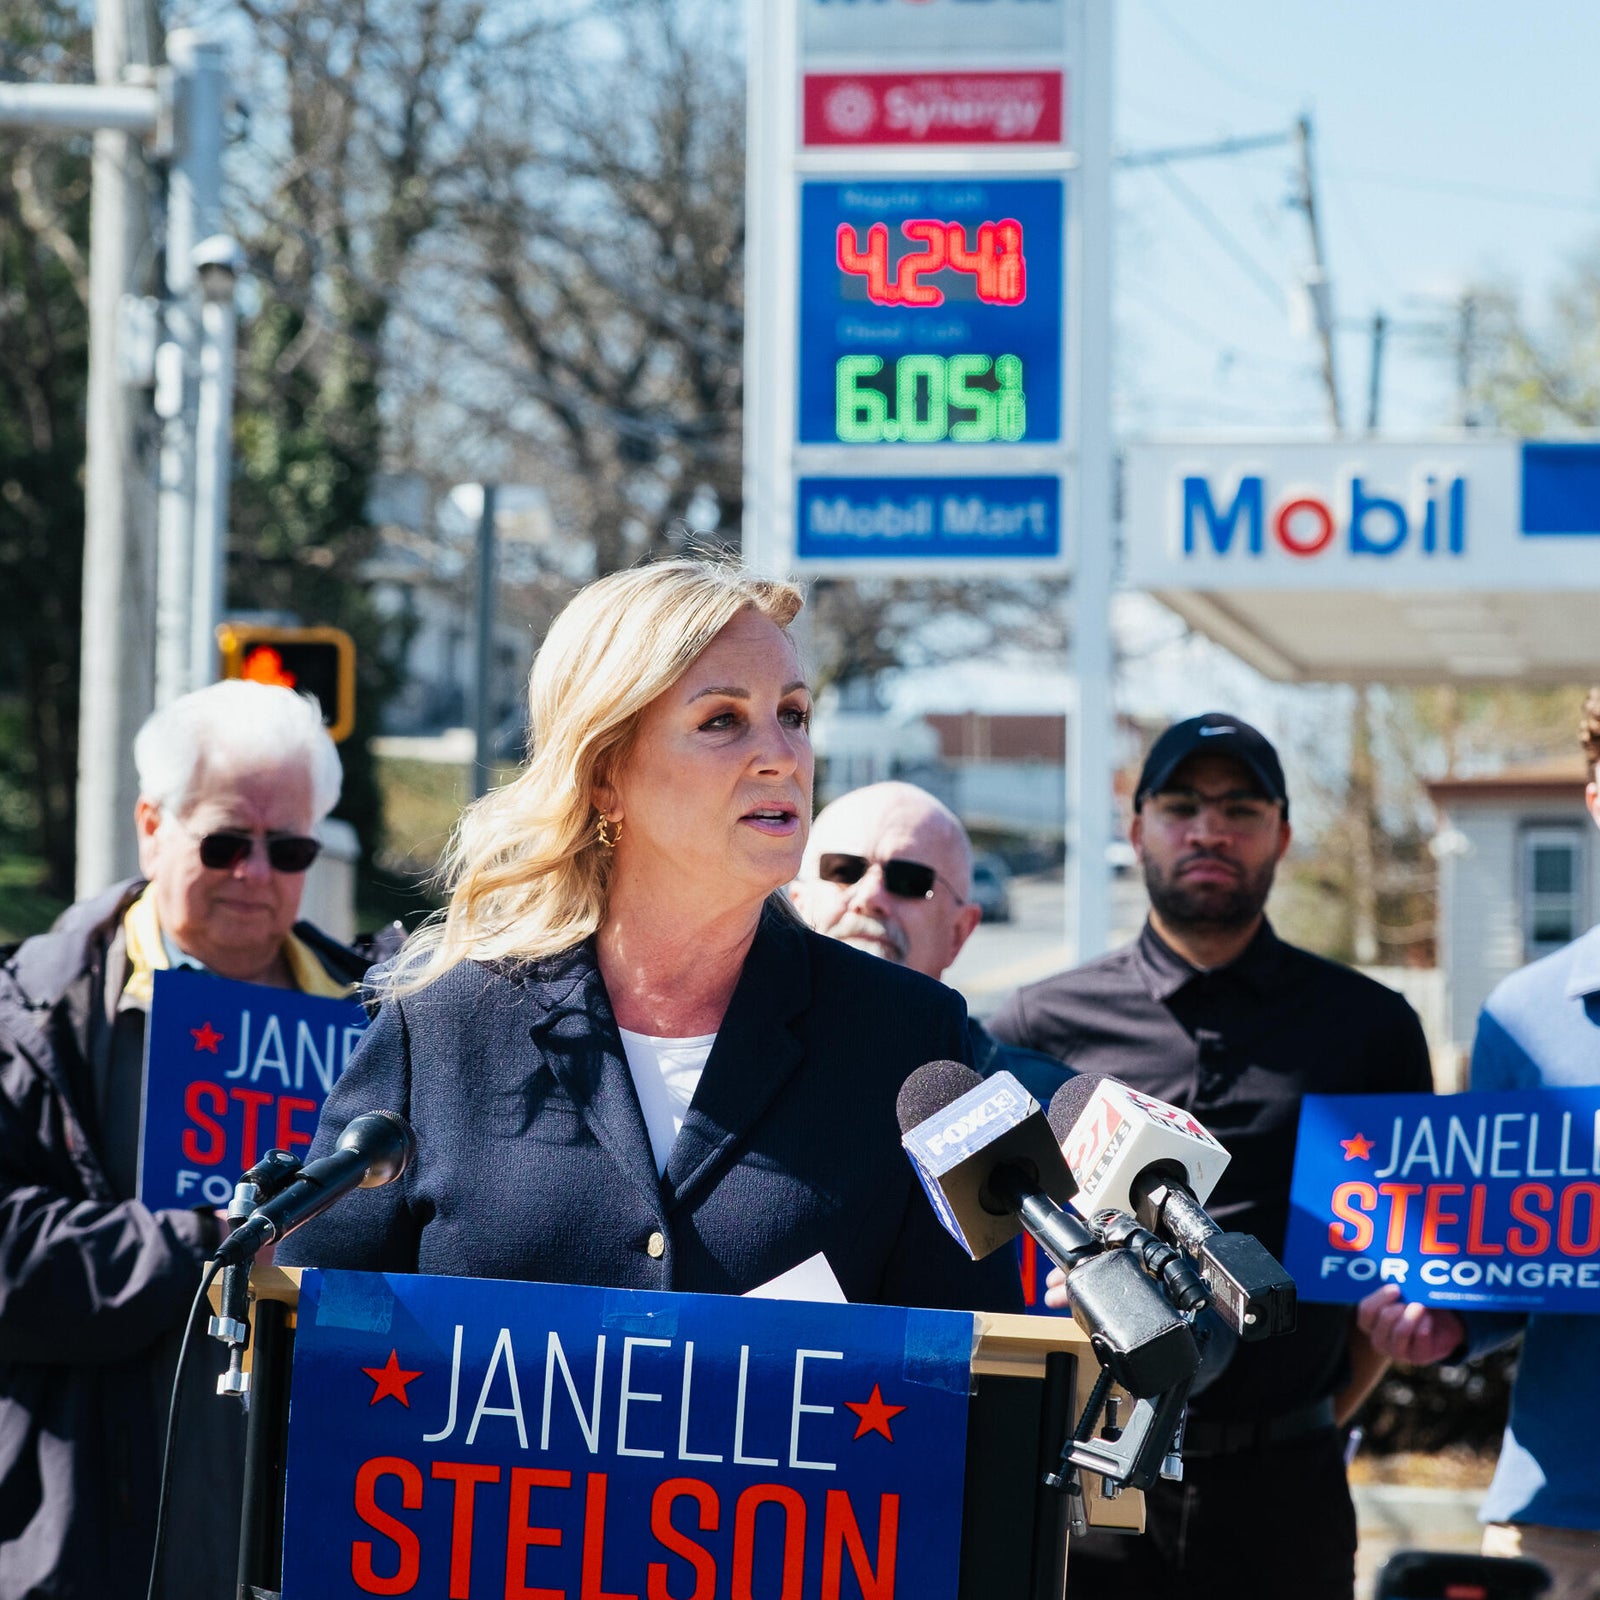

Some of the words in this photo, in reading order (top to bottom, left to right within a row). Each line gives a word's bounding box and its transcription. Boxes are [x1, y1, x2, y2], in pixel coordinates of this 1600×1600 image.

[885, 84, 1047, 138] Synergy
[809, 497, 934, 538] Mobil
[942, 497, 1047, 538] Mart
[1183, 475, 1465, 556] Mobil
[925, 1088, 1018, 1156] FOX43
[1084, 1120, 1131, 1195] NEWS
[1374, 1110, 1600, 1179] JANELL
[1328, 1181, 1600, 1257] STELSO
[1320, 1255, 1410, 1284] FOR
[1419, 1258, 1600, 1289] CONGRE
[423, 1325, 844, 1471] JANELLE
[351, 1456, 901, 1600] STELSON
